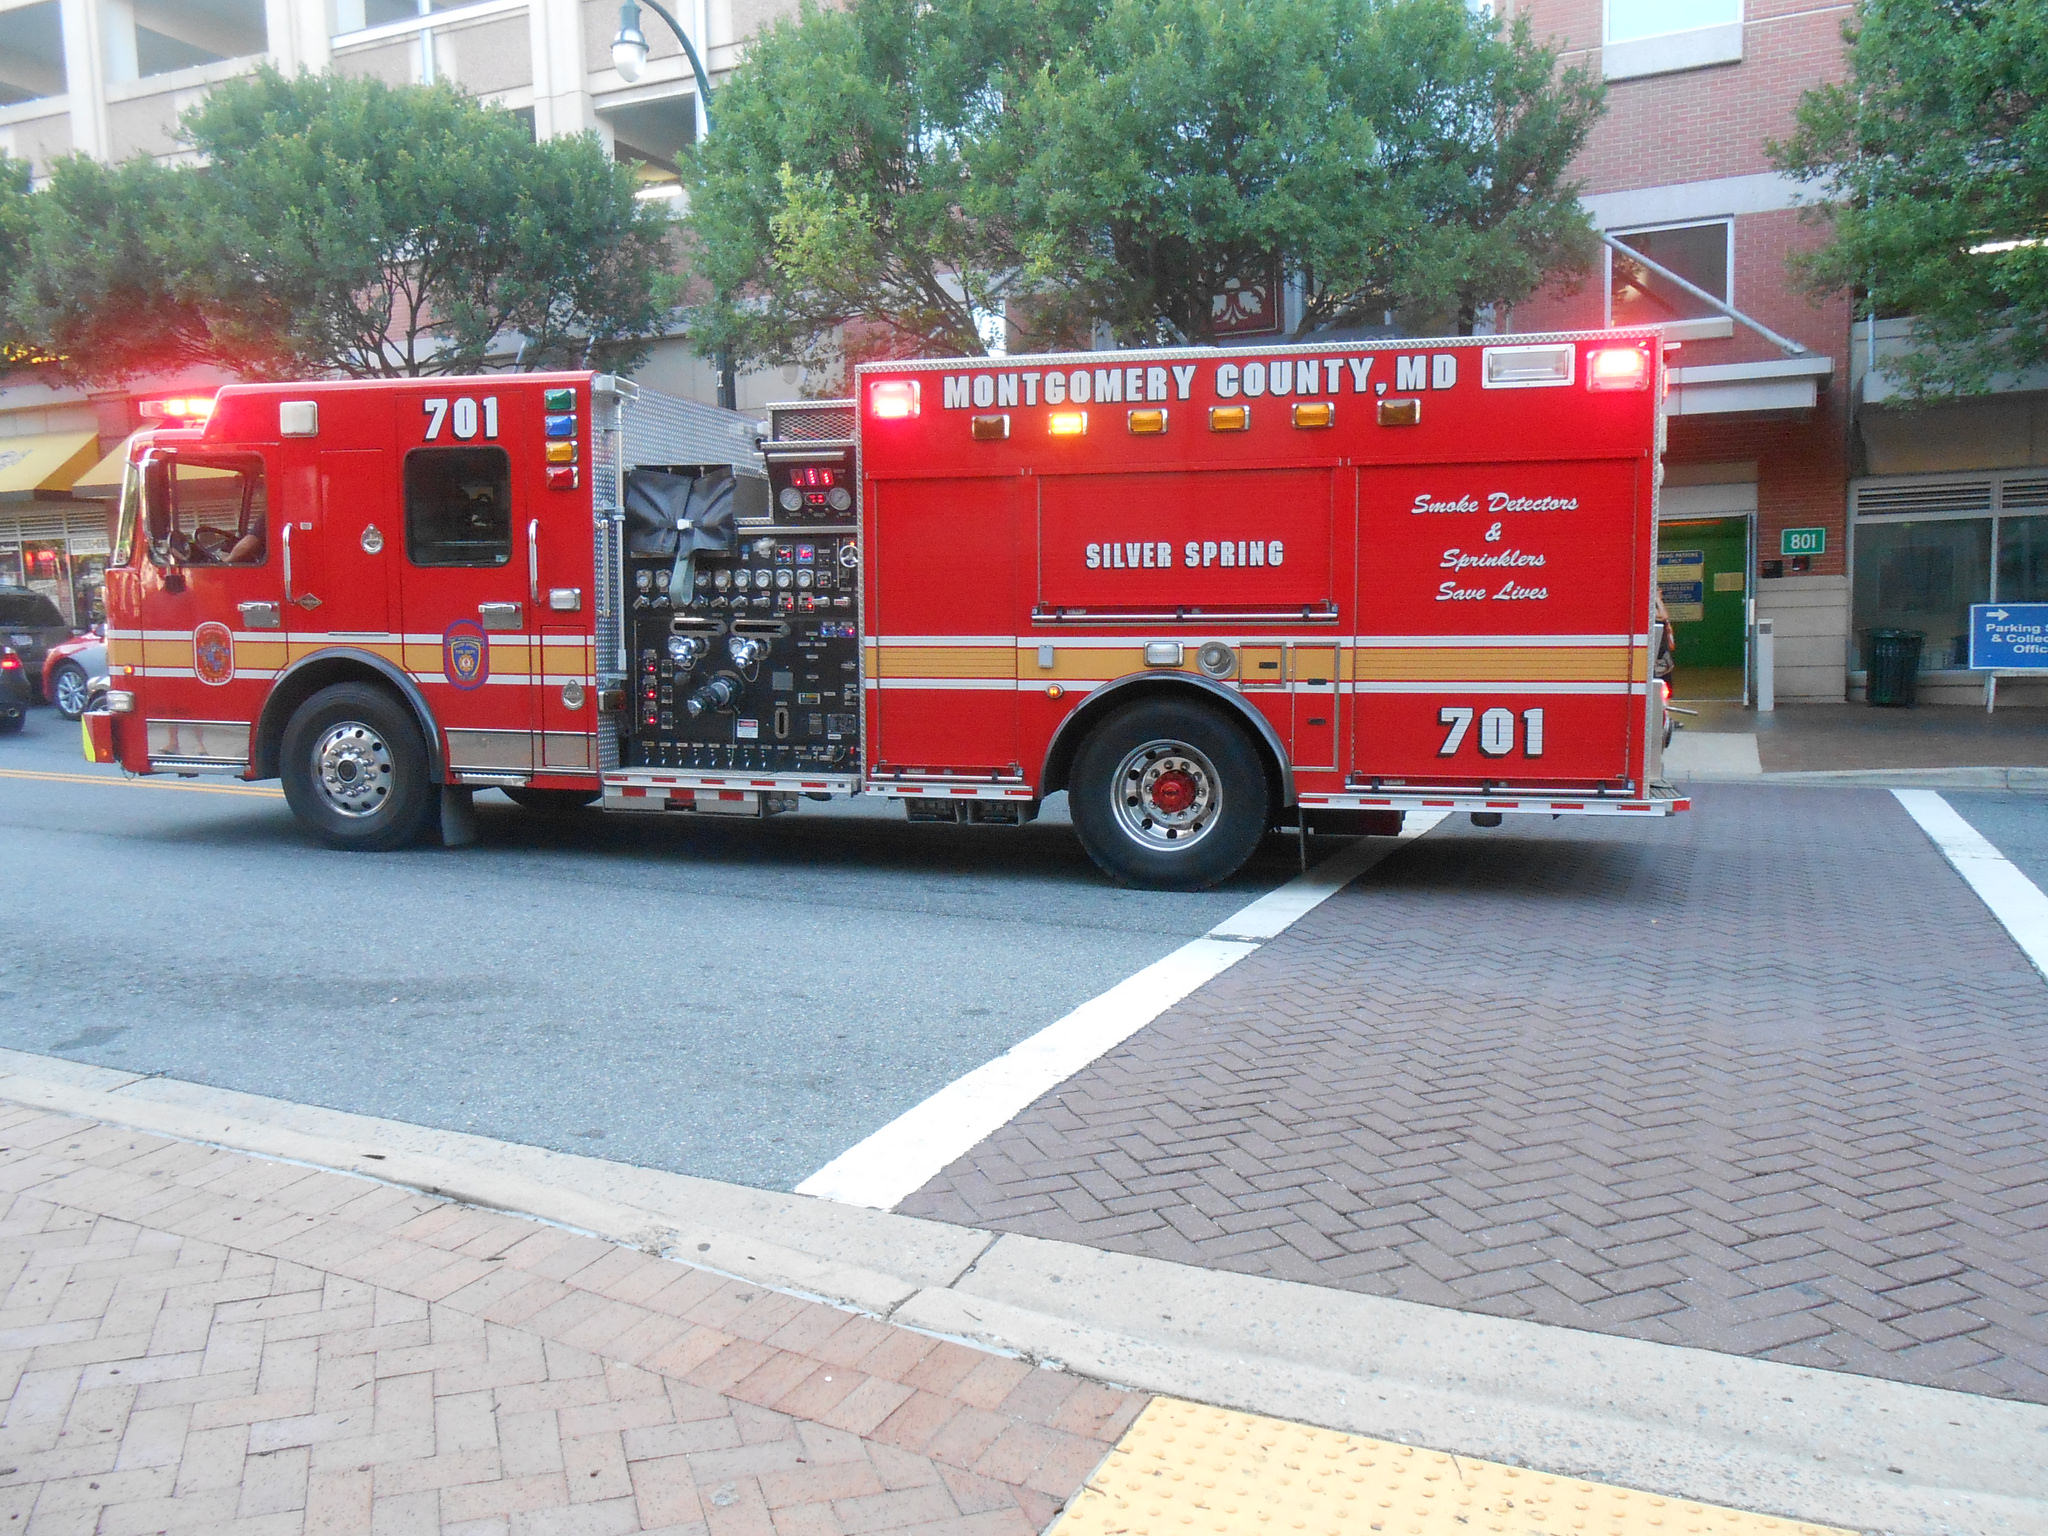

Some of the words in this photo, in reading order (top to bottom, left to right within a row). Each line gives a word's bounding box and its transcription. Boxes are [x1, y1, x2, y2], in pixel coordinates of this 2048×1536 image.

[943, 364, 1198, 410] MONTGOMERY
[1216, 356, 1388, 398] COUNTY,
[1395, 353, 1458, 392] MD
[422, 396, 498, 442] 701
[1411, 494, 1479, 515] Smoke
[1487, 492, 1580, 514] Detectors
[1484, 521, 1502, 543] &
[1791, 533, 1816, 549] 801
[1085, 541, 1173, 570] SILVER
[1184, 540, 1284, 568] SPRING
[1440, 548, 1547, 573] Sprinklers
[1435, 581, 1487, 601] Save
[1492, 580, 1549, 600] Lives
[1985, 623, 2041, 635] Parking
[1991, 633, 2002, 643] &
[2013, 644, 2048, 654] Offic
[1437, 707, 1544, 758] 701
